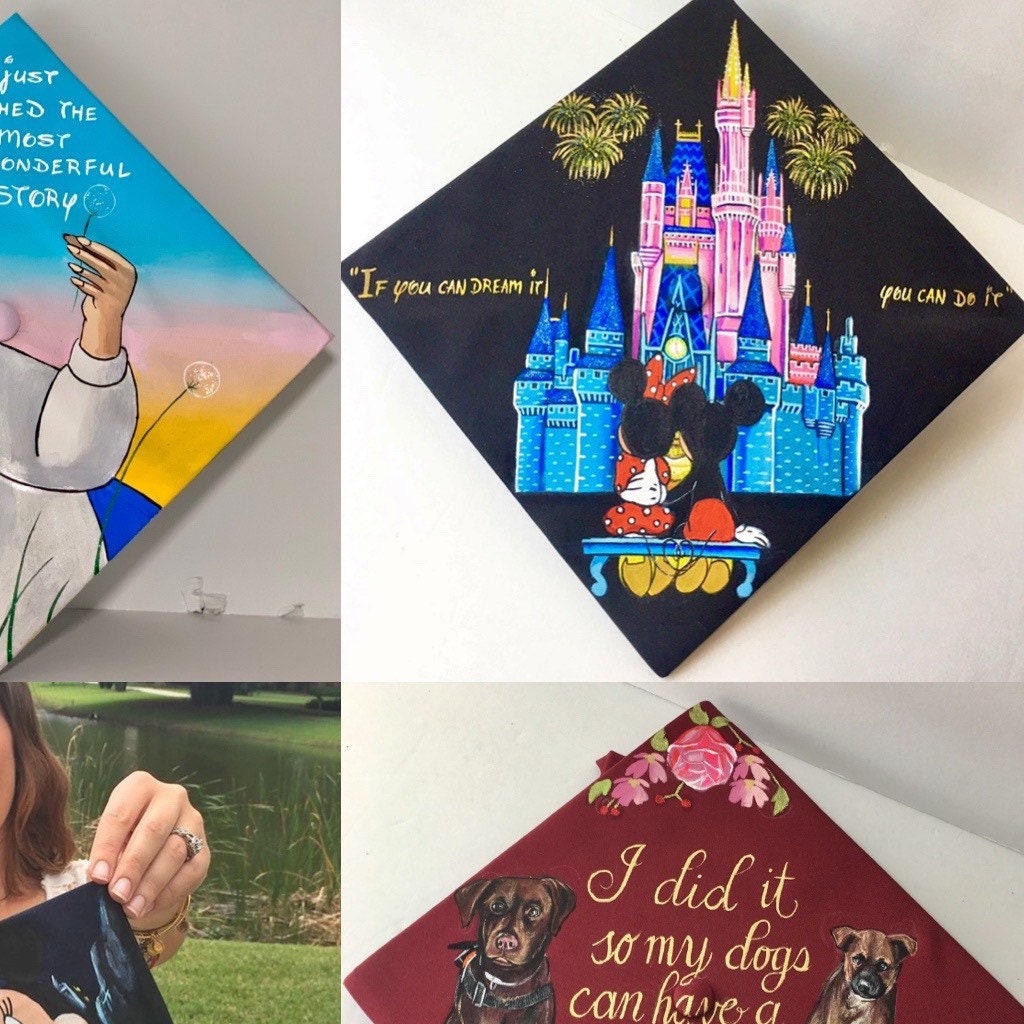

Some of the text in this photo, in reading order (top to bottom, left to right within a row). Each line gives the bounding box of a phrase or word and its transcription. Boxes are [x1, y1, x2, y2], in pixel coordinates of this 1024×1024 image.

[59, 100, 97, 121] THE
[438, 279, 466, 295] CAN
[470, 278, 523, 295] DREAM
[917, 287, 947, 305] CAN
[953, 289, 976, 307] DO
[587, 844, 798, 919] I did it
[591, 919, 810, 993] so my dogs
[569, 987, 645, 1022] can
